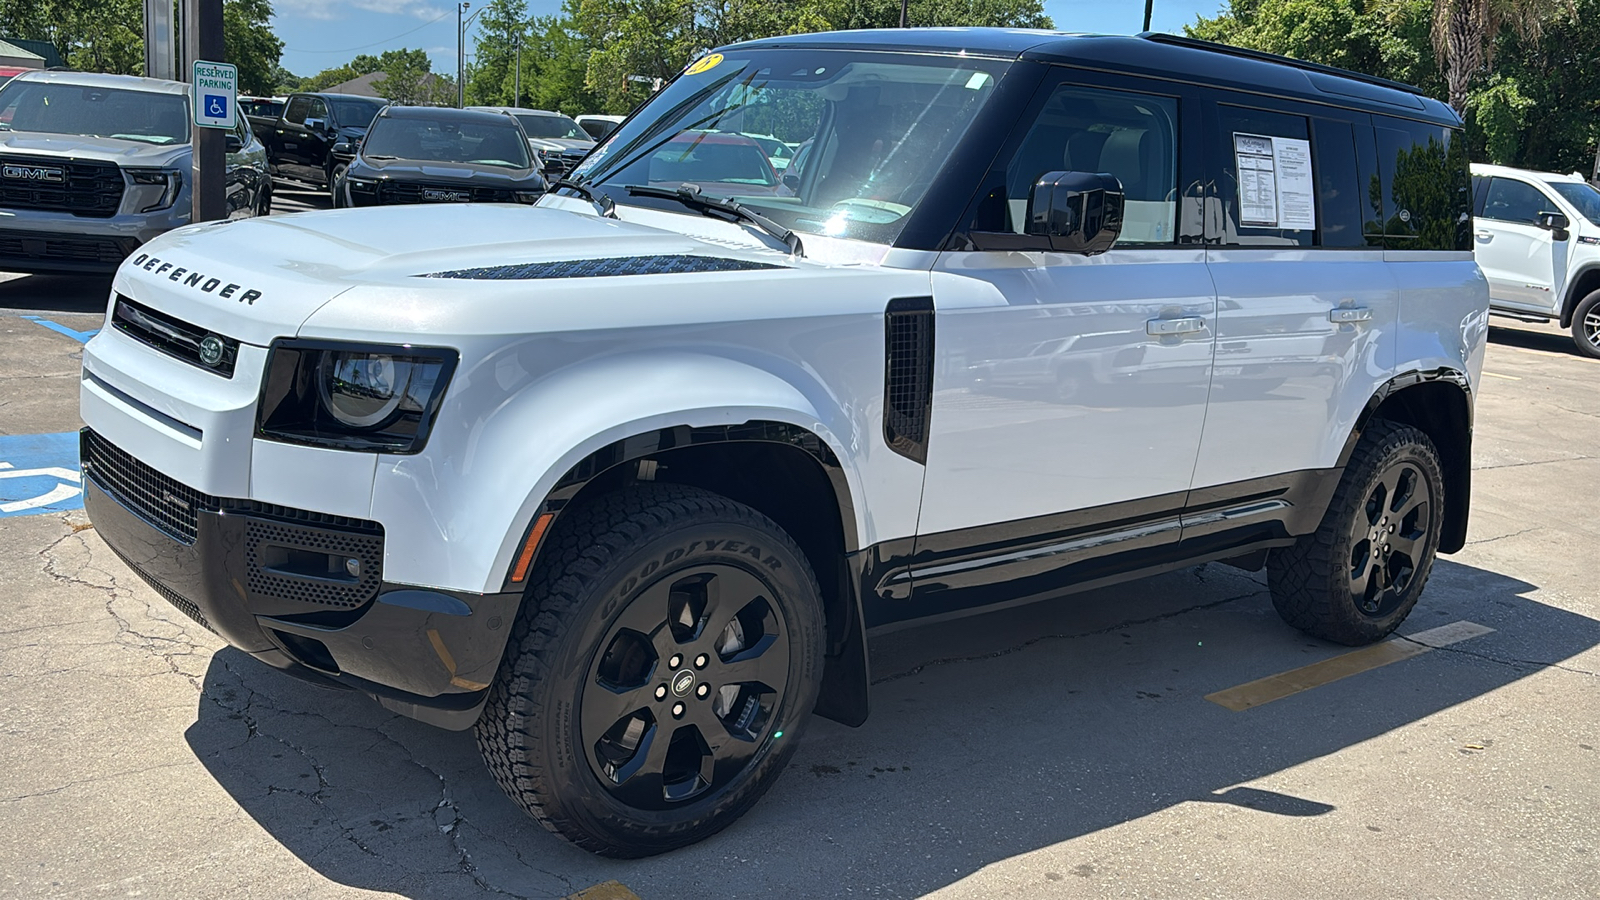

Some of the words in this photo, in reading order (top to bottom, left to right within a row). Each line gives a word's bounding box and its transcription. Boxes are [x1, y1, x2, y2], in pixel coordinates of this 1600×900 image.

[196, 67, 234, 79] RESERVED
[199, 79, 232, 90] PARKING
[2, 166, 62, 181] GMC
[424, 190, 470, 202] GMC
[132, 253, 263, 306] DEFENDER
[601, 538, 783, 620] GOODYEAR
